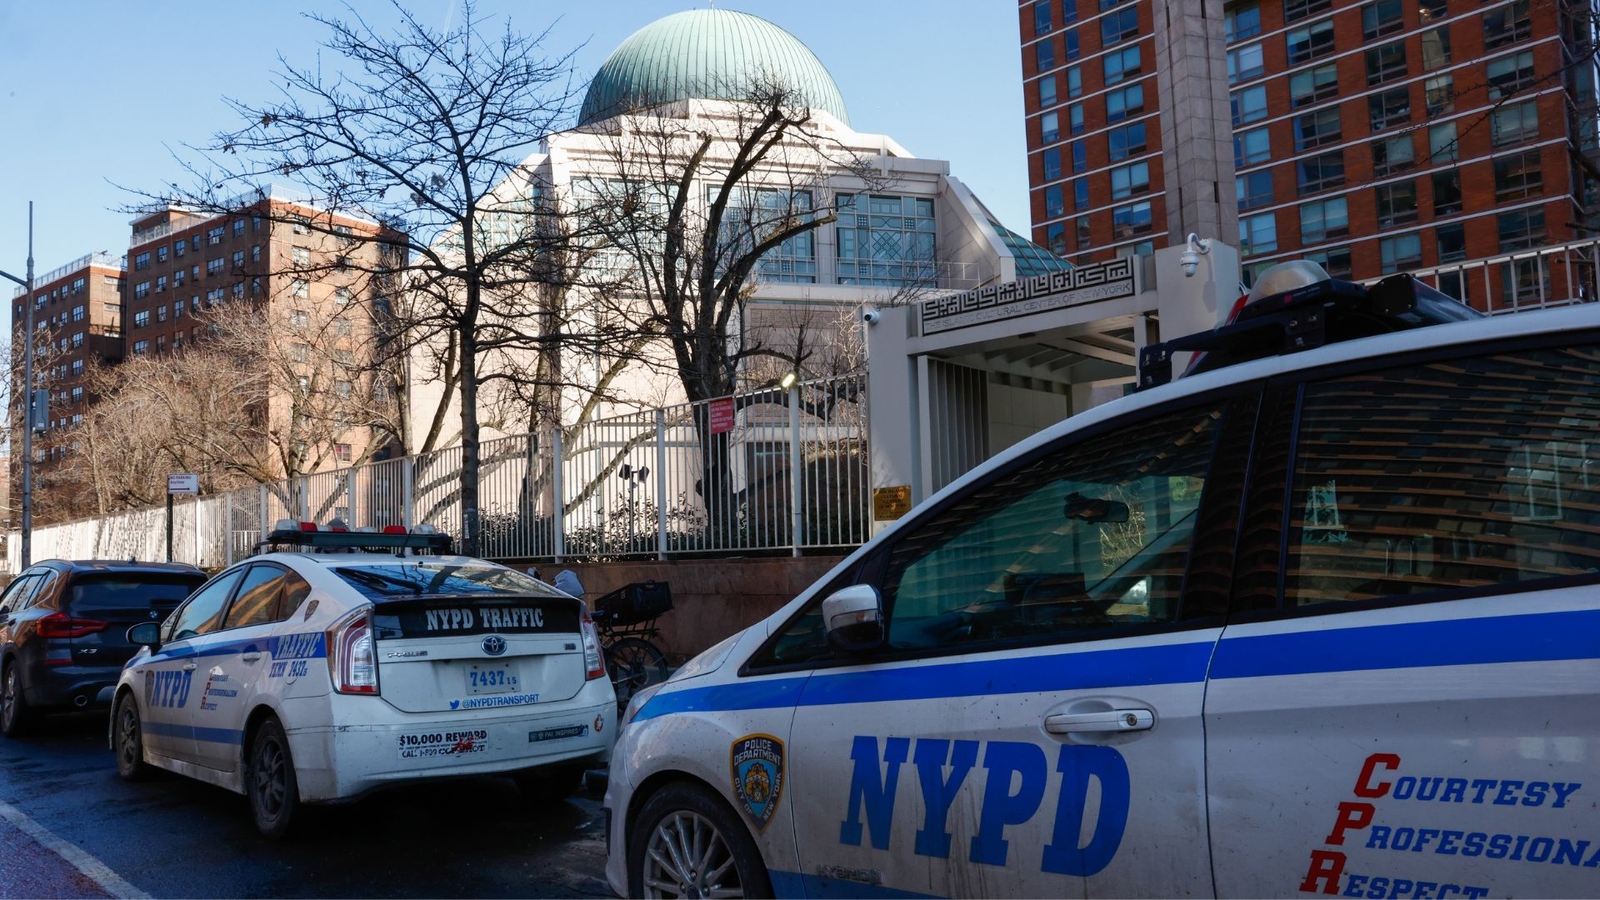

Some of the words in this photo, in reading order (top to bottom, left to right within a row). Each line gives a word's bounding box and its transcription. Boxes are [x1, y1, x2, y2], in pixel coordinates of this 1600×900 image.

[1024, 297, 1060, 311] CENTER
[1062, 294, 1075, 303] OF
[1077, 288, 1100, 300] NEW
[1103, 282, 1131, 295] YORK
[425, 608, 474, 630] NYPD
[480, 607, 544, 628] TRAFFIC
[274, 632, 322, 659] TRAFFIC
[151, 671, 192, 708] NYPD
[470, 670, 505, 687] 7437
[507, 676, 517, 685] 15
[462, 694, 540, 708] @NYPDTRANSPORT
[399, 733, 443, 747] $10,000
[445, 730, 487, 742] REWARD
[744, 739, 772, 751] POLICE
[733, 749, 781, 766] DEPARTMENT
[734, 777, 745, 799] CITY
[1353, 753, 1582, 808] COURTESY
[762, 801, 775, 820] NEW
[772, 772, 782, 797] YORK
[840, 735, 1131, 877] NYPD
